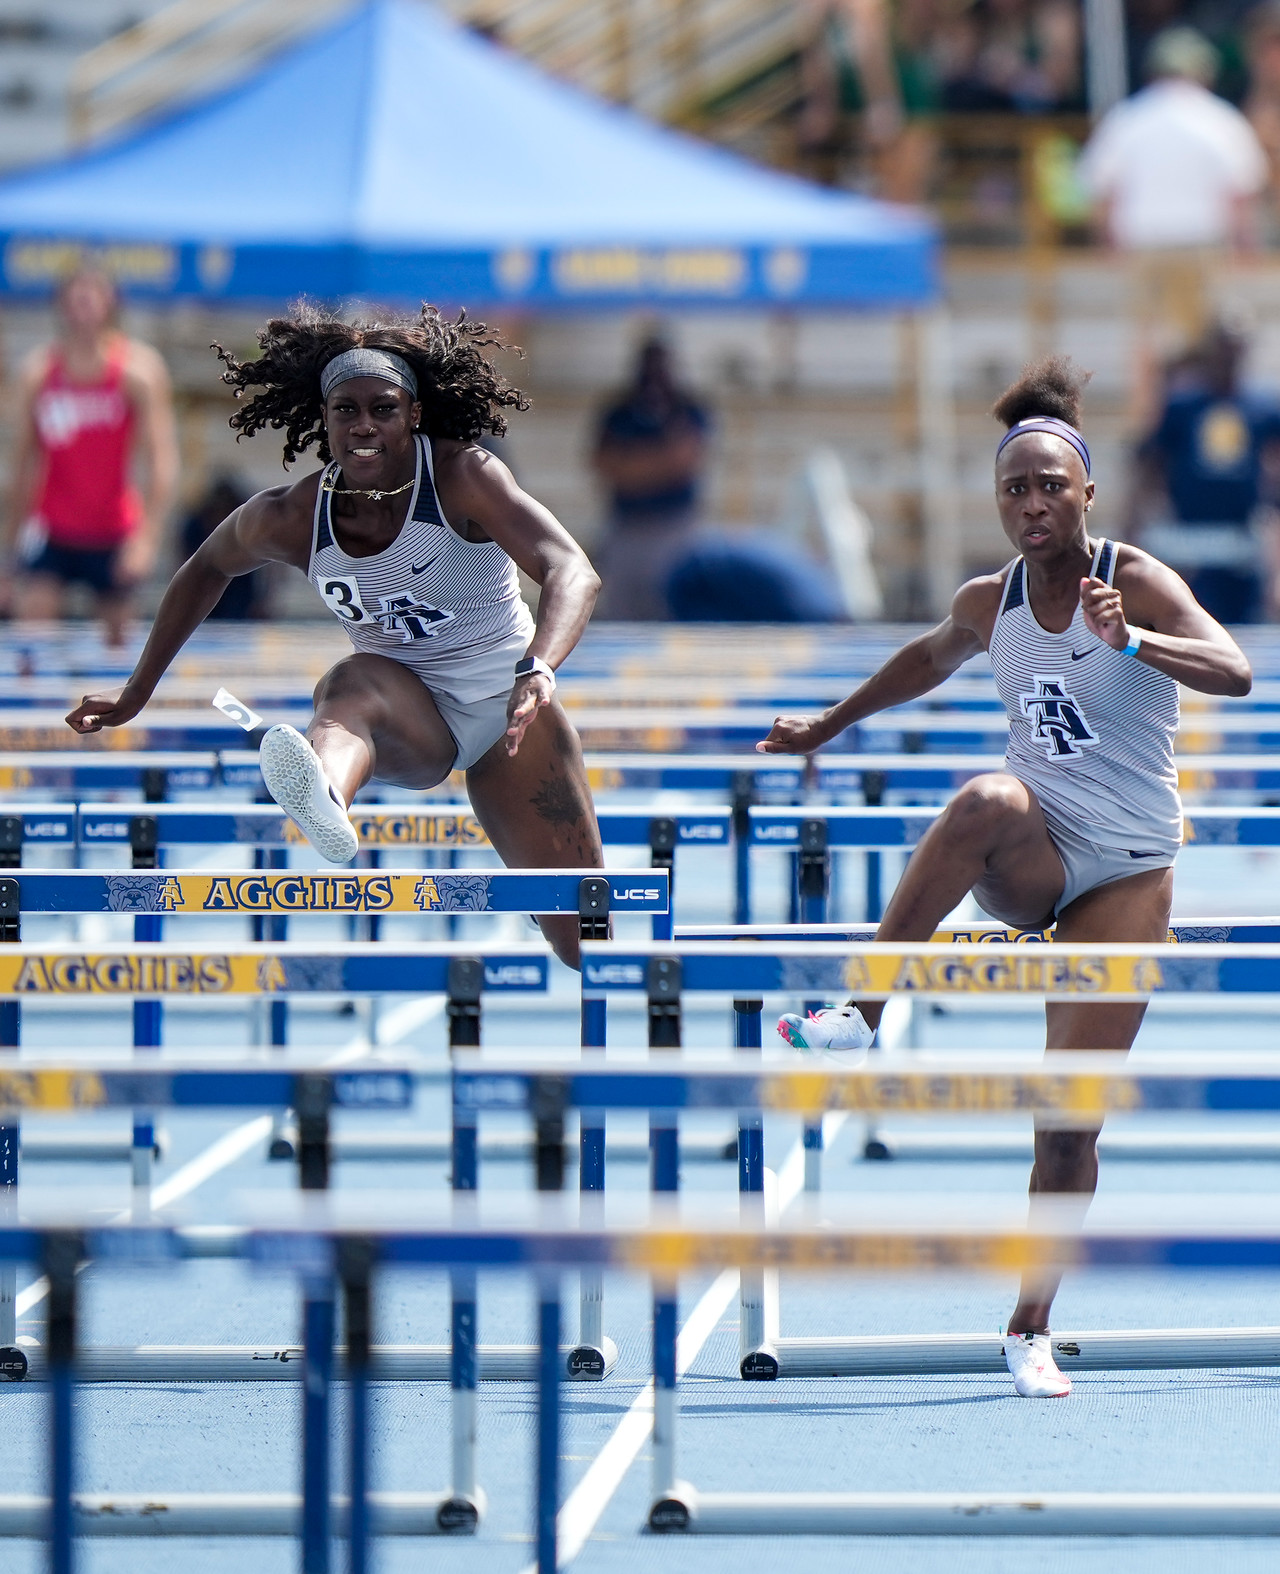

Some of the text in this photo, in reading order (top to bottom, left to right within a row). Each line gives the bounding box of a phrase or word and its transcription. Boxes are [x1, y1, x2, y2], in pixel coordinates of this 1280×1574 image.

[325, 581, 363, 621] 3
[25, 823, 67, 836] UCS
[86, 823, 128, 836] UCS
[680, 825, 723, 838] UCS
[755, 825, 798, 838] UCS
[203, 877, 393, 911] AGGIES
[613, 889, 660, 900] UCS
[13, 955, 233, 992] AGGIES
[484, 965, 542, 984] UCS
[586, 964, 644, 983] UCS
[891, 956, 1109, 991] AGGIES
[572, 1360, 600, 1370] UCS
[745, 1365, 774, 1375] UCS
